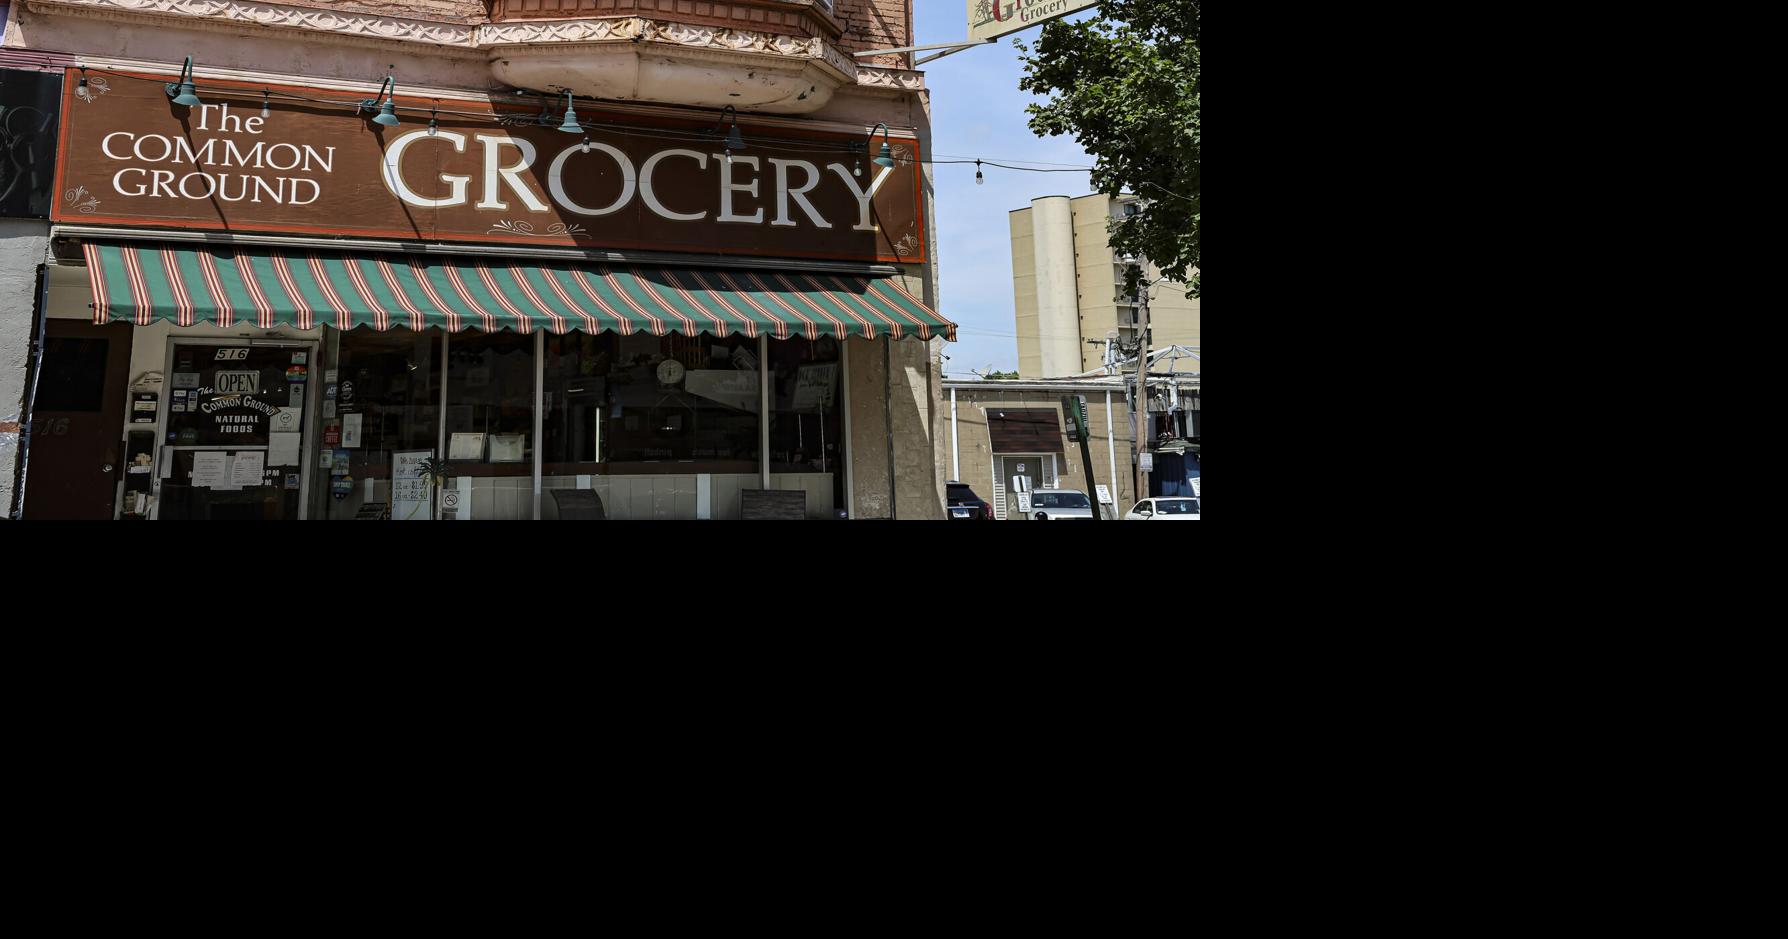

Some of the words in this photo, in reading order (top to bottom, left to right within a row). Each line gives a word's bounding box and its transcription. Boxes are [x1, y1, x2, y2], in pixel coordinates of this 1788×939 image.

[1020, 0, 1068, 22] Grocery
[196, 104, 266, 136] The
[101, 131, 337, 173] COMMON
[112, 167, 322, 206] GROUND
[382, 130, 895, 233] GROCERY
[217, 349, 248, 359] 516
[196, 386, 215, 396] The
[218, 373, 256, 392] OPEN
[200, 398, 242, 414] COMMON
[243, 395, 276, 416] GROUND
[215, 415, 260, 423] NATURAL
[220, 425, 253, 433] FOODS
